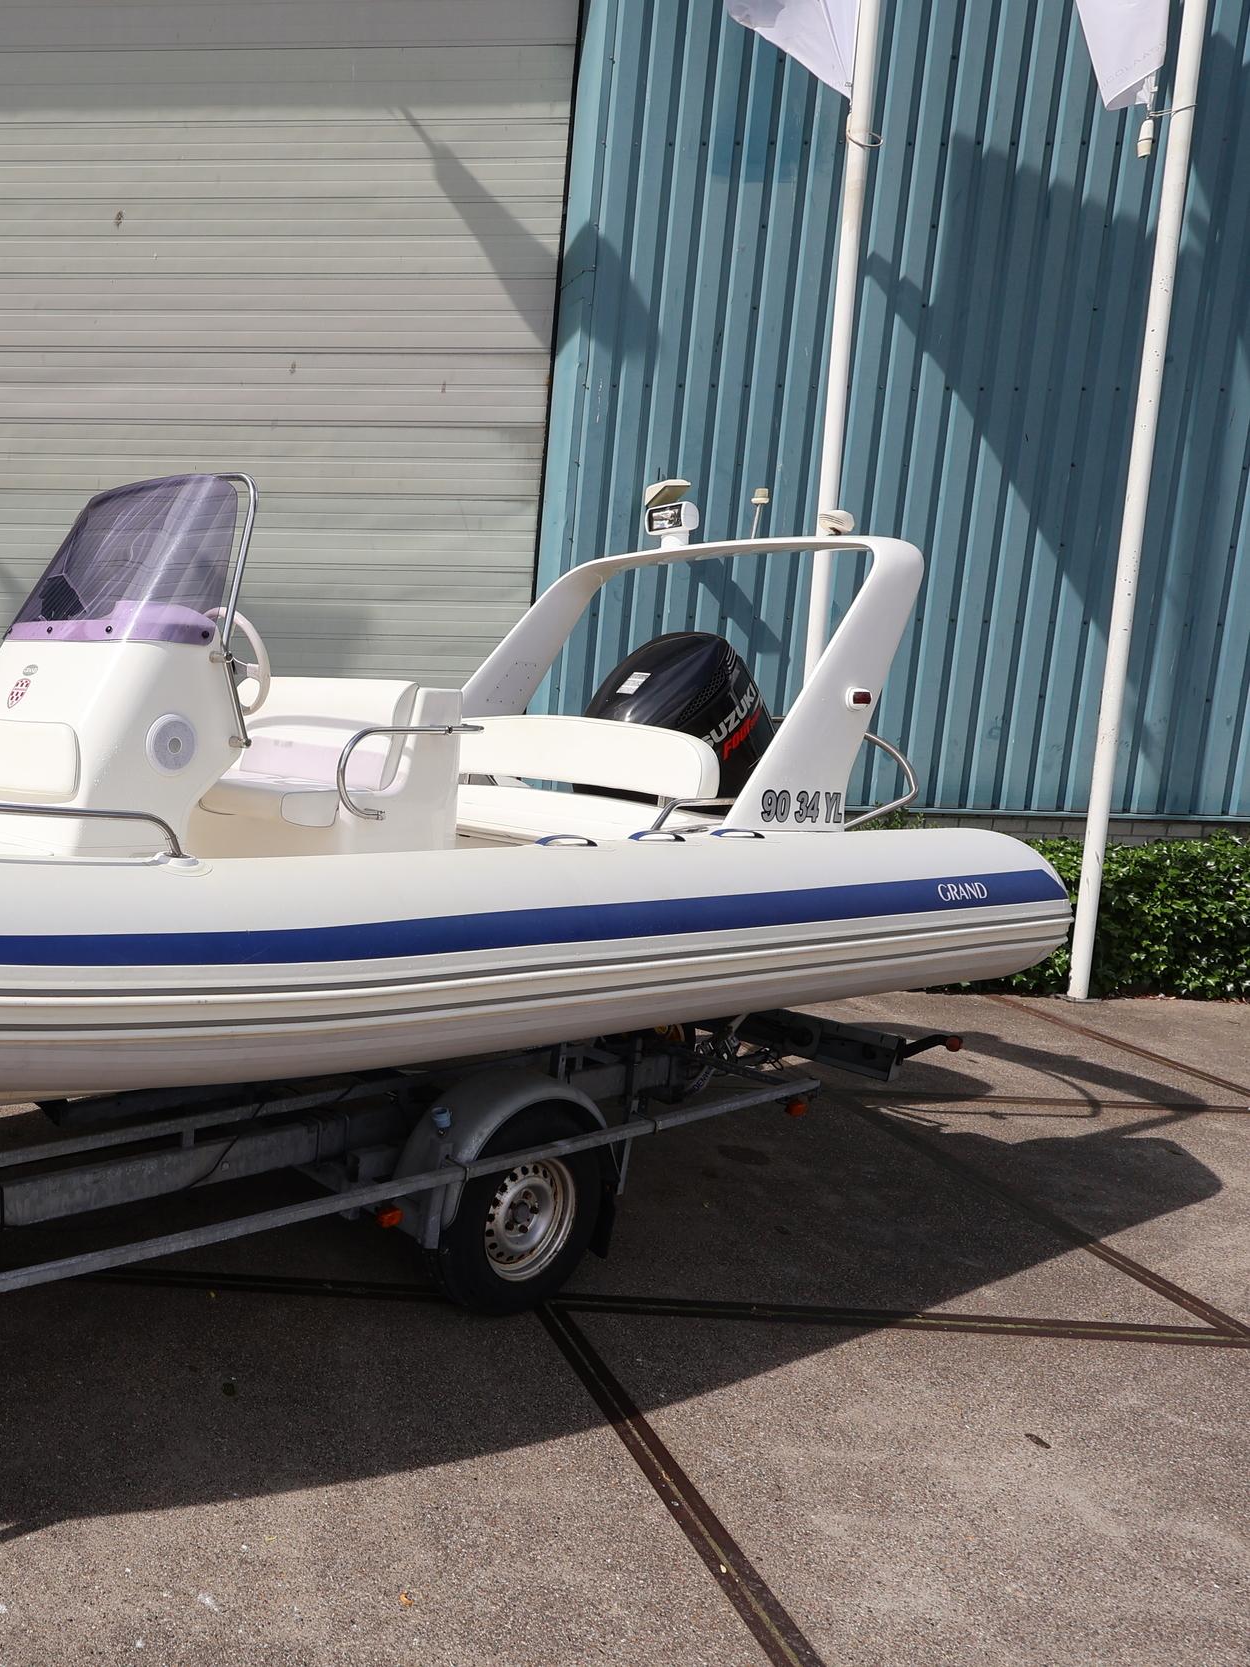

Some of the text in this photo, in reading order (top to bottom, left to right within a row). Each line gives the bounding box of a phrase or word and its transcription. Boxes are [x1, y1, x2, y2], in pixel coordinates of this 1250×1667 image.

[761, 789, 842, 823] 90 34 YL
[937, 882, 988, 902] GRAND
